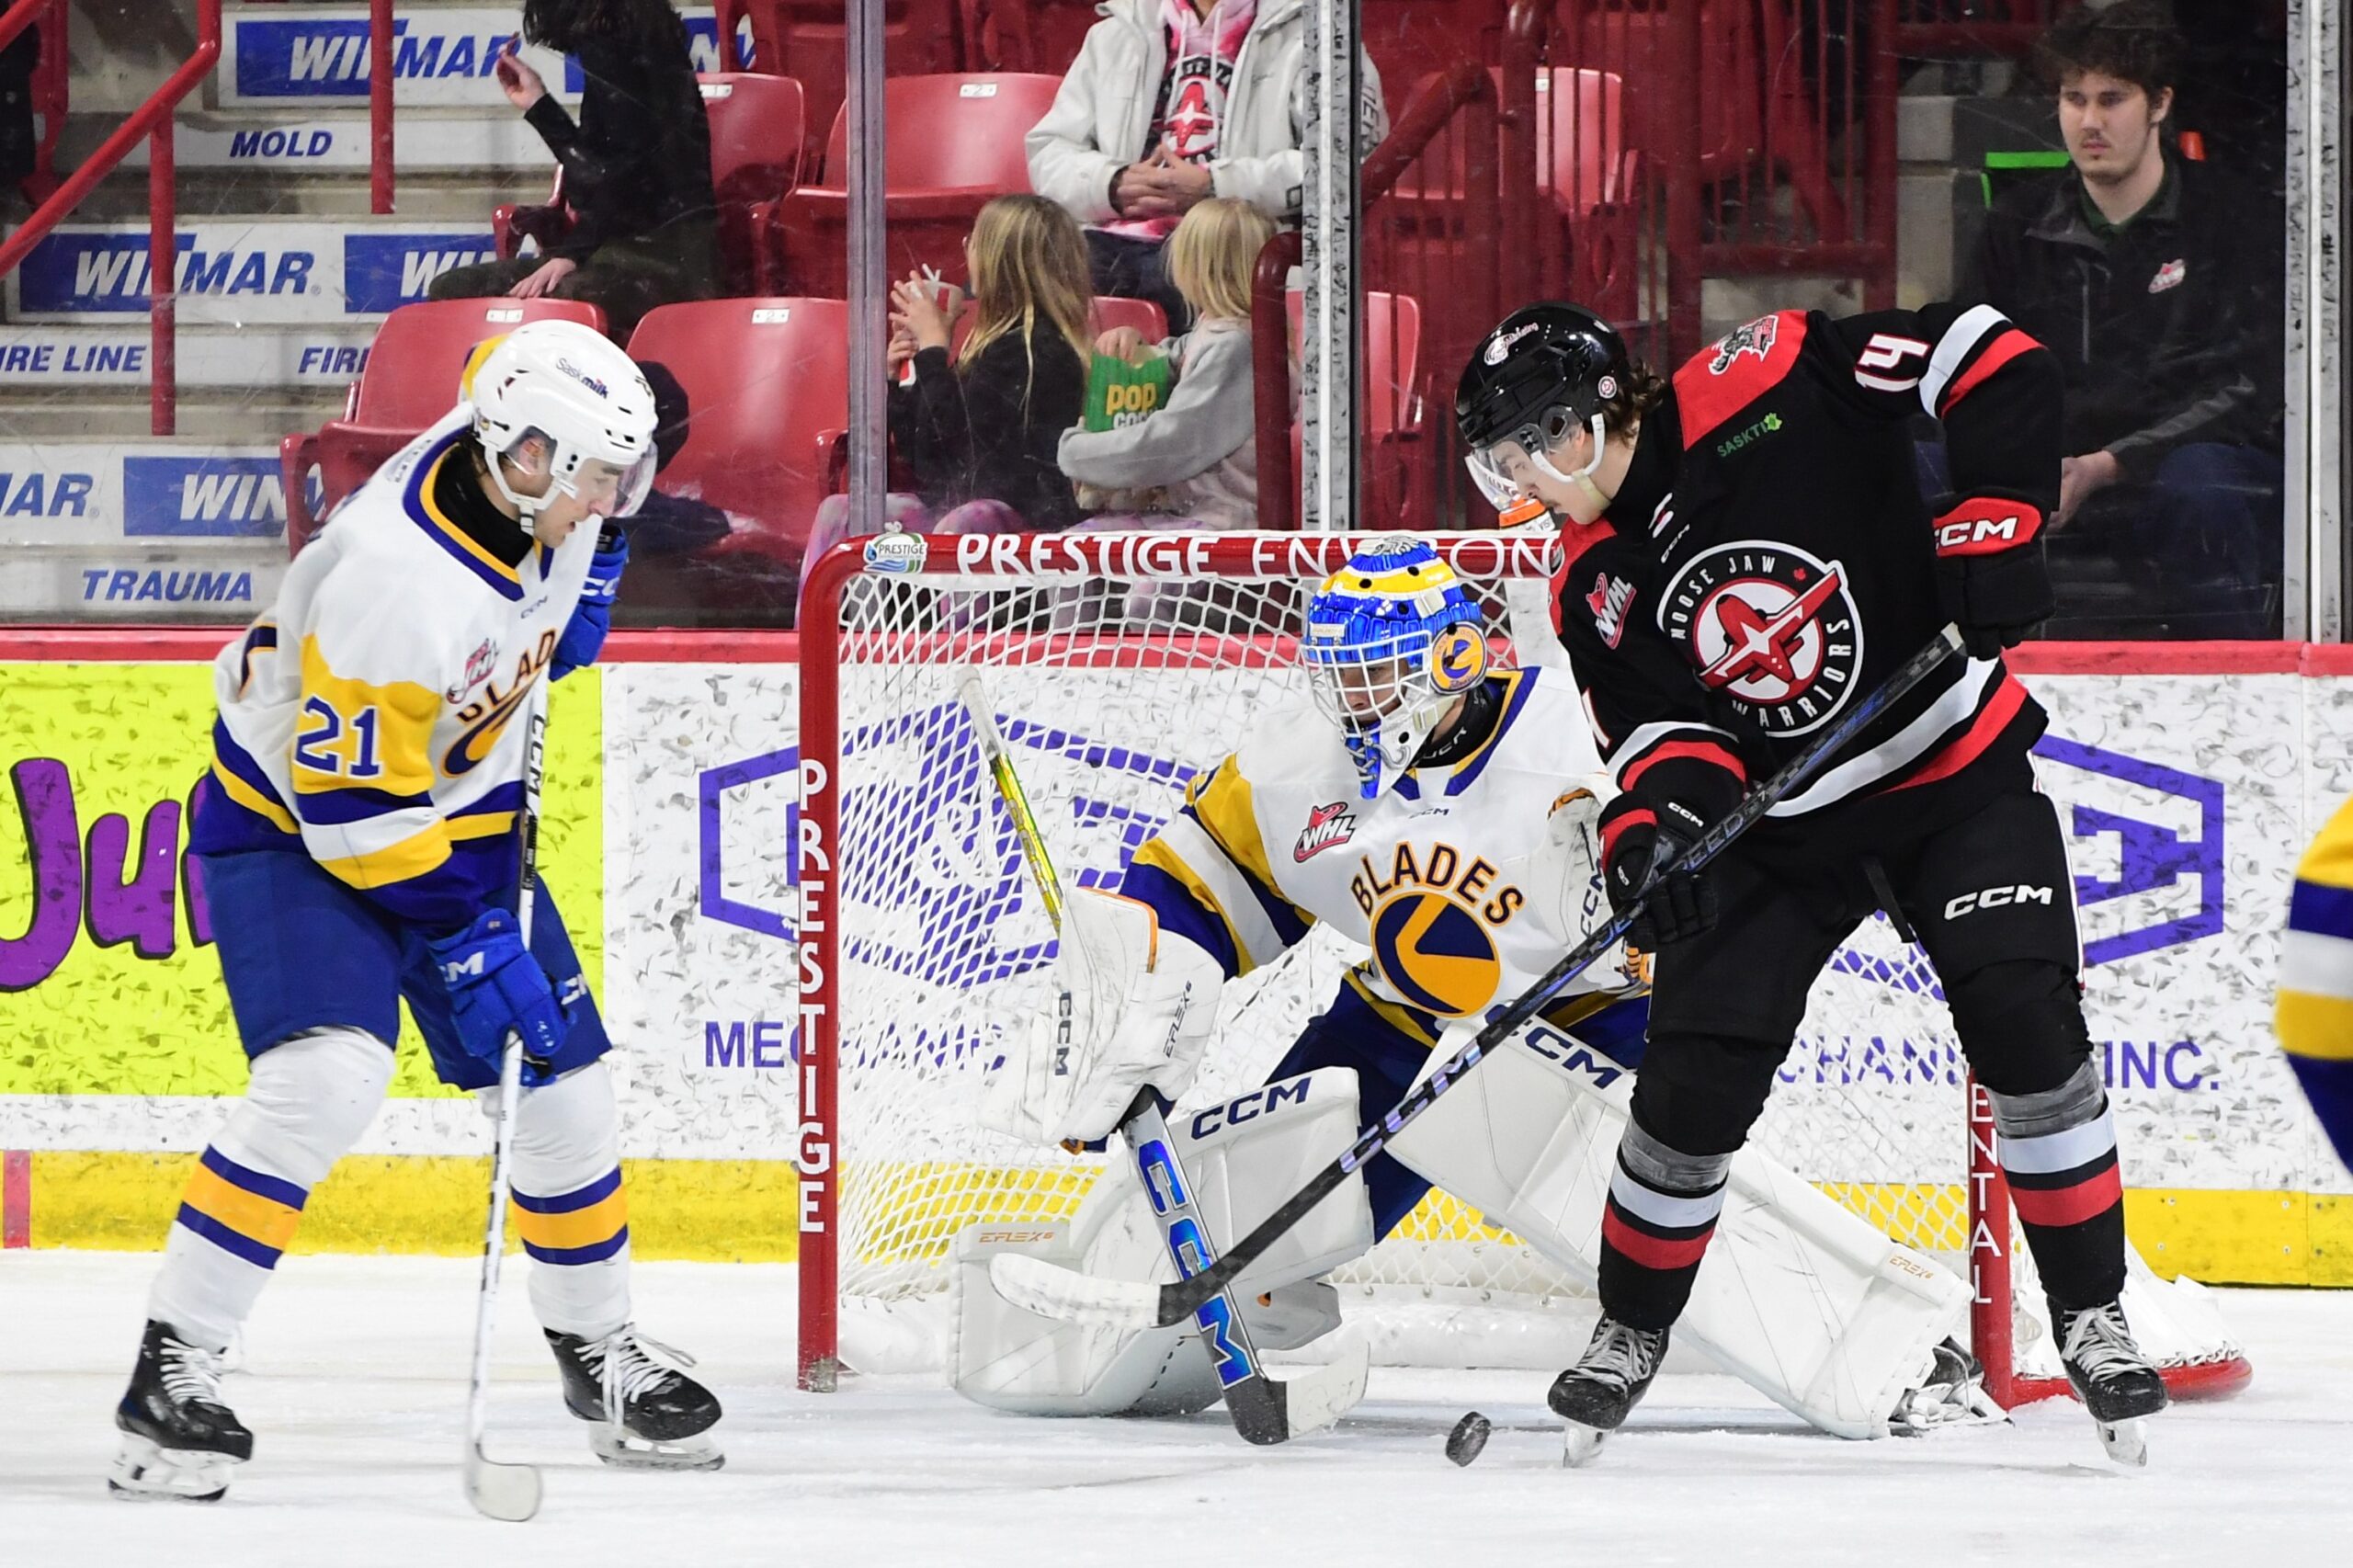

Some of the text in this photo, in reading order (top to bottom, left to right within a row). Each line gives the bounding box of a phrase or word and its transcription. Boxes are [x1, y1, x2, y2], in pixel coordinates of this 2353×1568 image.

[230, 131, 333, 157] MOLD
[63, 345, 147, 372] LINE
[1854, 333, 1931, 392] 14
[1106, 382, 1156, 416] POP
[0, 473, 94, 517] AR
[879, 544, 926, 555] PRESTIGE
[957, 534, 1211, 576] PRESTIGE
[1729, 554, 1776, 574] JAW
[83, 570, 253, 602] TRAUMA
[1596, 575, 1636, 636] WHL
[293, 695, 383, 778] 21
[528, 713, 545, 798] CCM
[1298, 813, 1356, 853] WHL
[0, 757, 215, 994] Ju
[1350, 840, 1527, 927] BLADES
[1944, 884, 2053, 921] CCM
[799, 758, 831, 1233] PRESTIGE
[1054, 990, 1072, 1075] CCM
[2105, 1040, 2220, 1091] INC.
[1191, 1076, 1313, 1141] CCM
[1339, 1039, 1482, 1174] CCM
[1137, 1139, 1256, 1391] CCM
